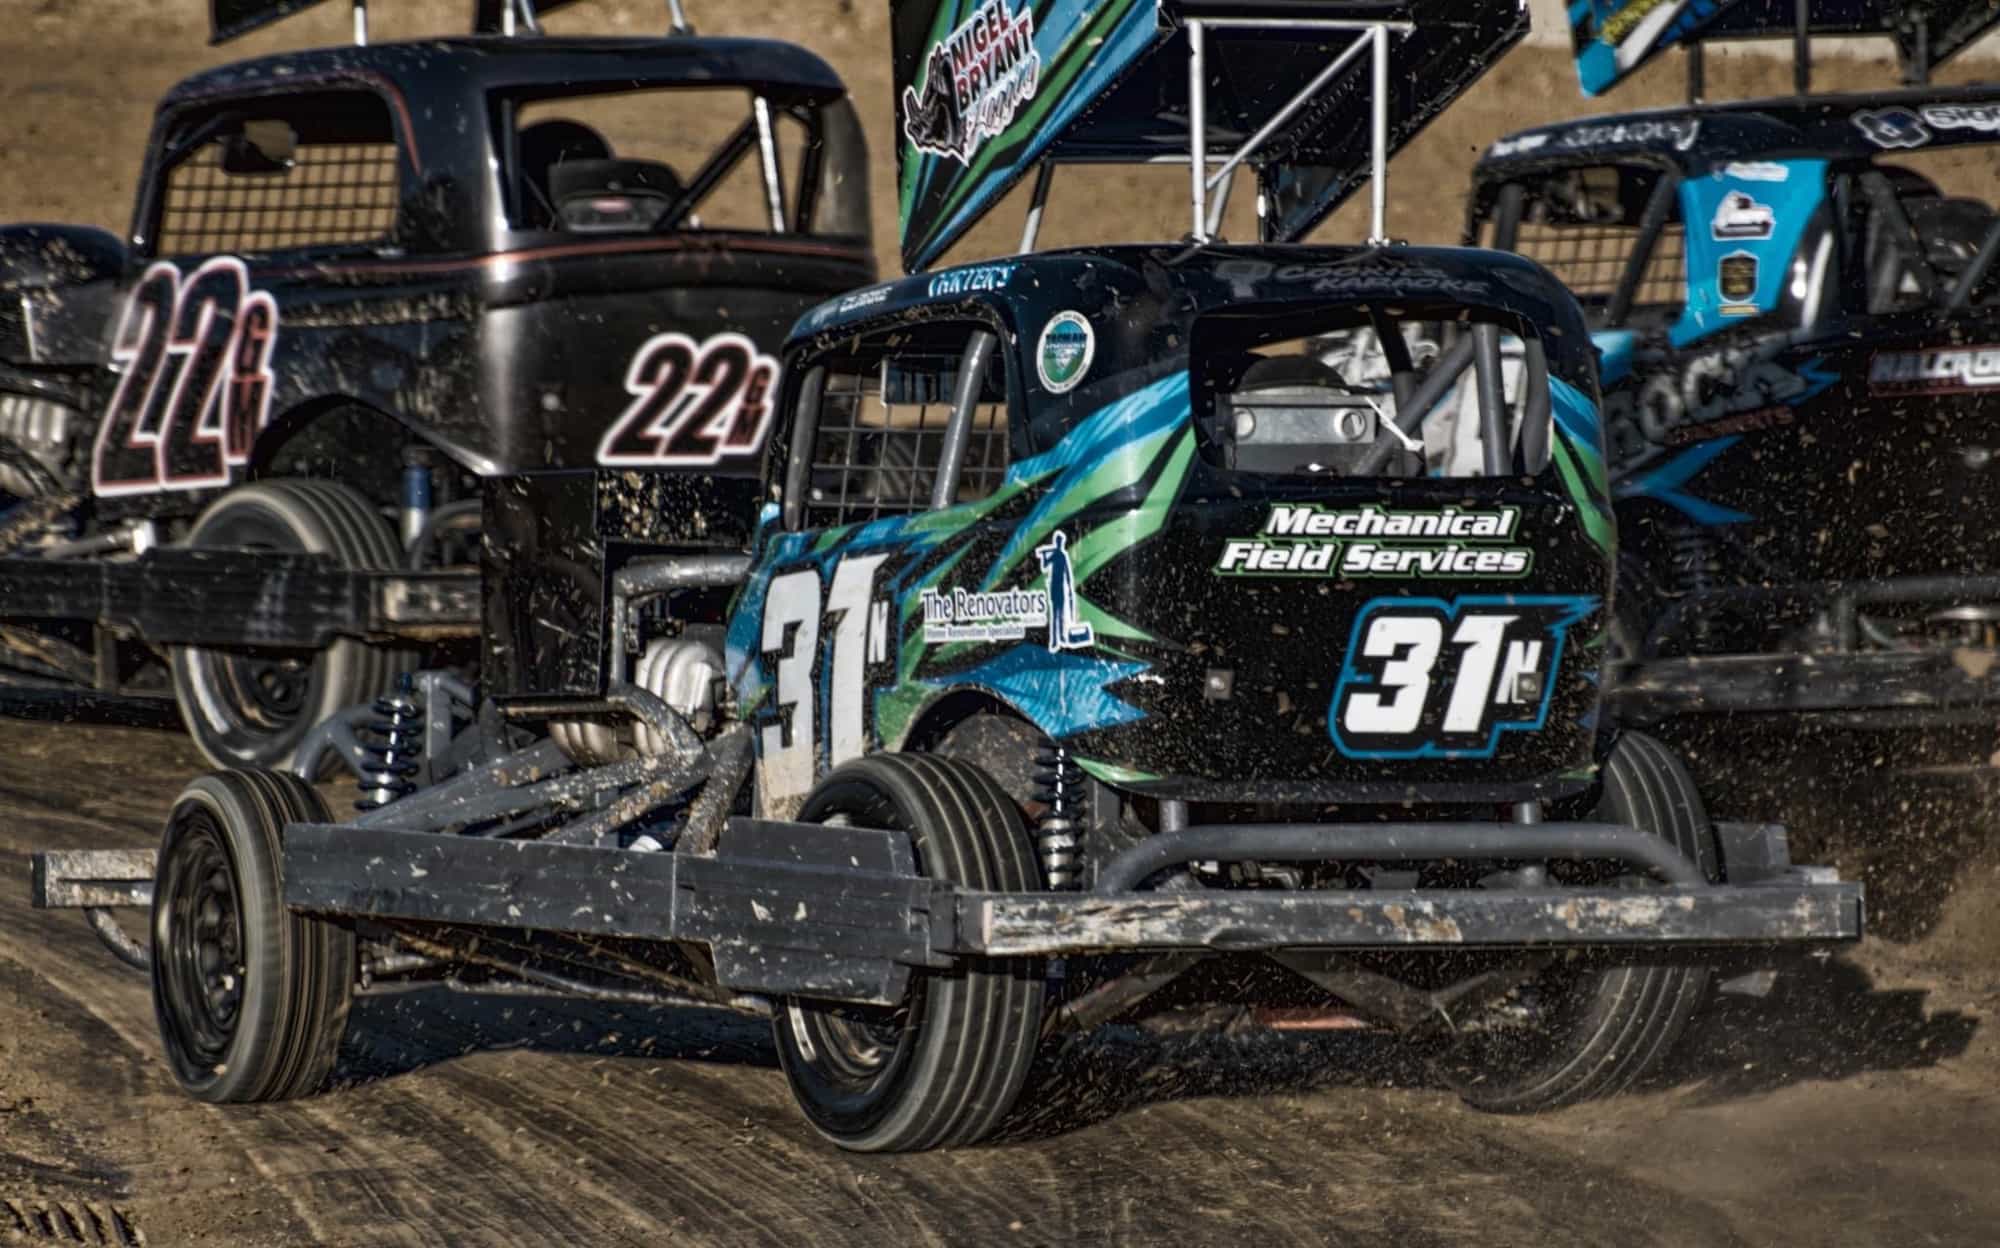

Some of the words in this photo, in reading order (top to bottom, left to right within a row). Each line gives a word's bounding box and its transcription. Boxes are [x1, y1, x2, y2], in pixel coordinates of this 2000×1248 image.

[950, 0, 1009, 76] NIGEL
[956, 19, 1030, 112] BRYANT
[1265, 507, 1515, 536] Mechanical
[1218, 541, 1335, 571] Field
[1342, 543, 1528, 573] Services
[922, 592, 953, 620] The
[956, 590, 1046, 618] Renovators
